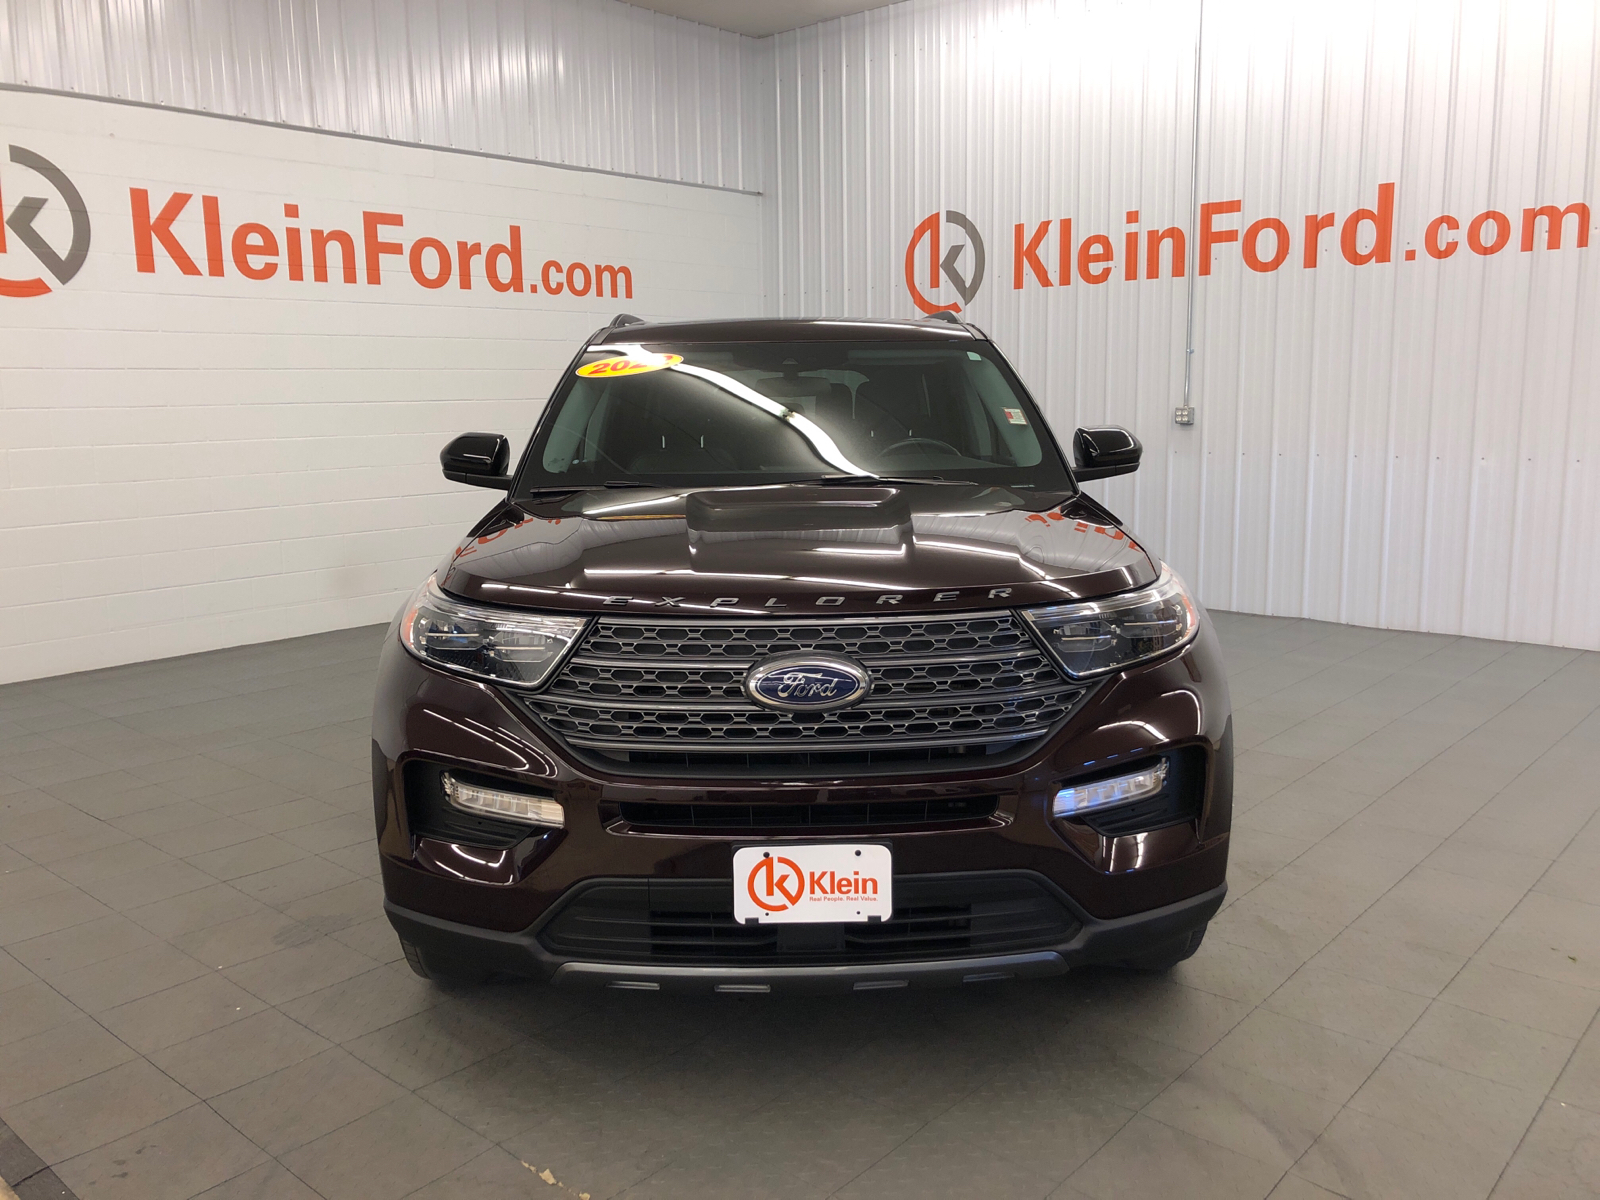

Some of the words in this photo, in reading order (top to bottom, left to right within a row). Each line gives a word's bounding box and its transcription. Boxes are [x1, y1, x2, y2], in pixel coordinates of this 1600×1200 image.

[129, 187, 633, 299] KleinFord.com
[1013, 182, 1591, 289] KleinFord.com
[588, 354, 675, 375] 202
[603, 587, 1012, 607] EXPLORER
[777, 672, 838, 697] Ford
[809, 870, 878, 895] Klein
